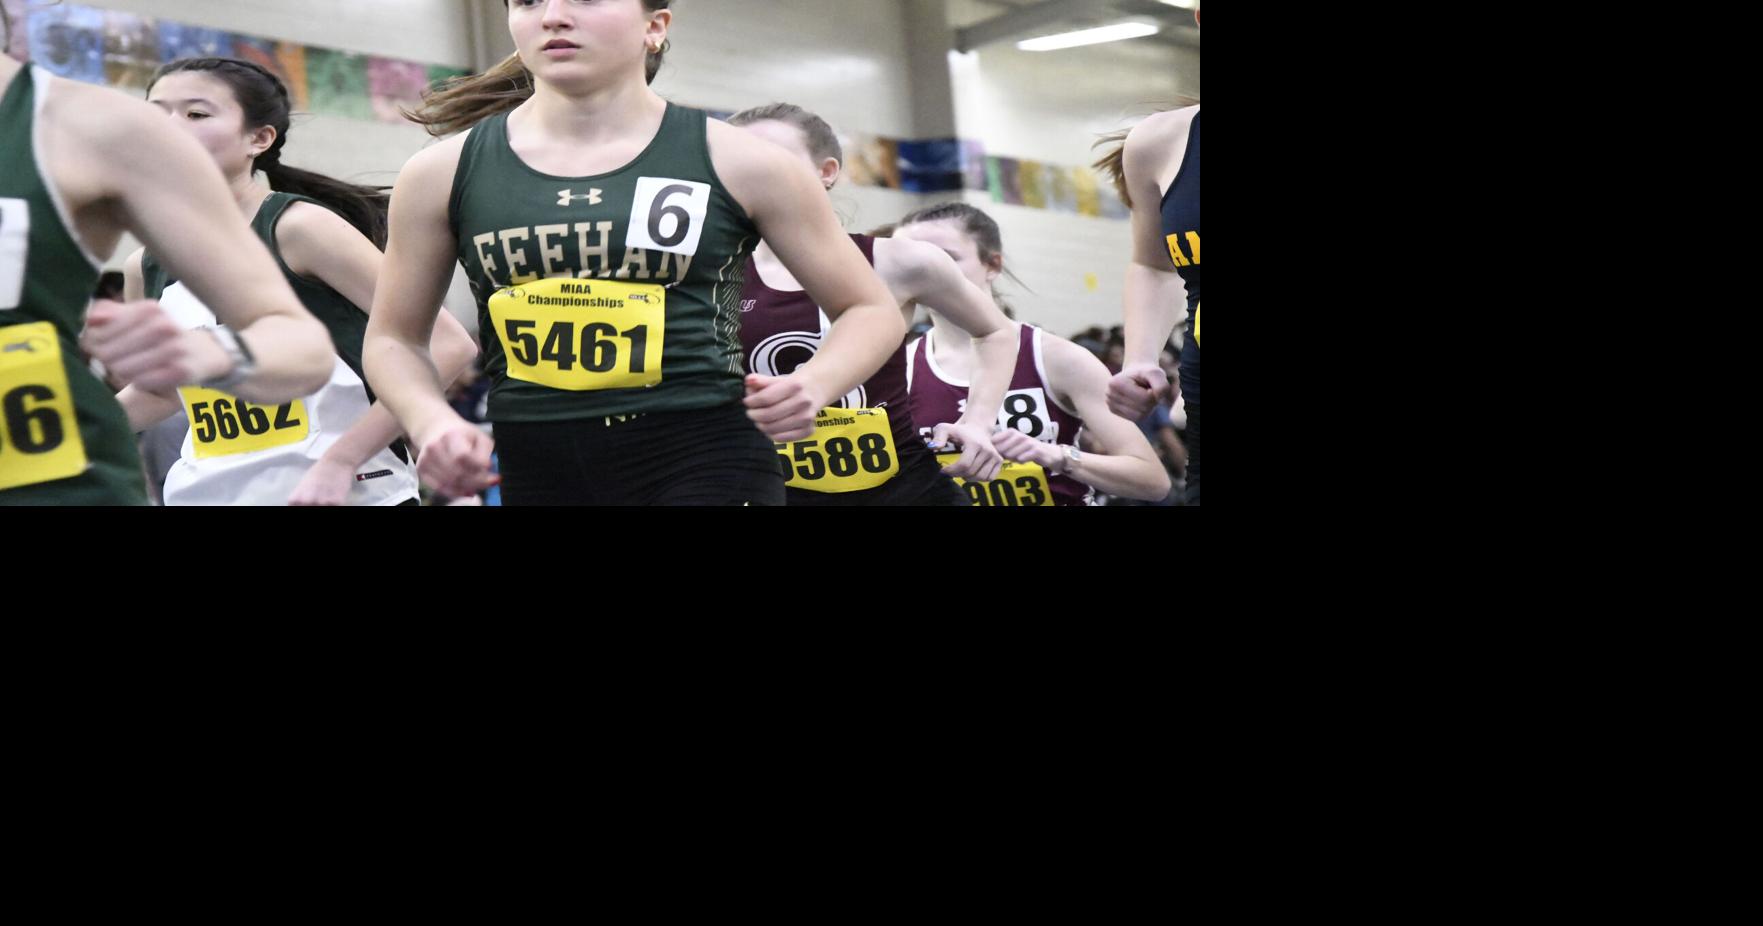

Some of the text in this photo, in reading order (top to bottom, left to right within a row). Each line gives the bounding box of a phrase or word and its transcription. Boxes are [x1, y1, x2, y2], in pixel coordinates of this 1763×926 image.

[646, 183, 694, 248] 6
[472, 220, 693, 286] FEEHAN
[527, 294, 625, 309] Championships
[560, 283, 592, 295] MIAA
[504, 319, 648, 374] 5461
[0, 384, 65, 455] 6
[191, 398, 301, 443] 5662
[814, 416, 855, 428] onships
[1003, 393, 1043, 438] 8
